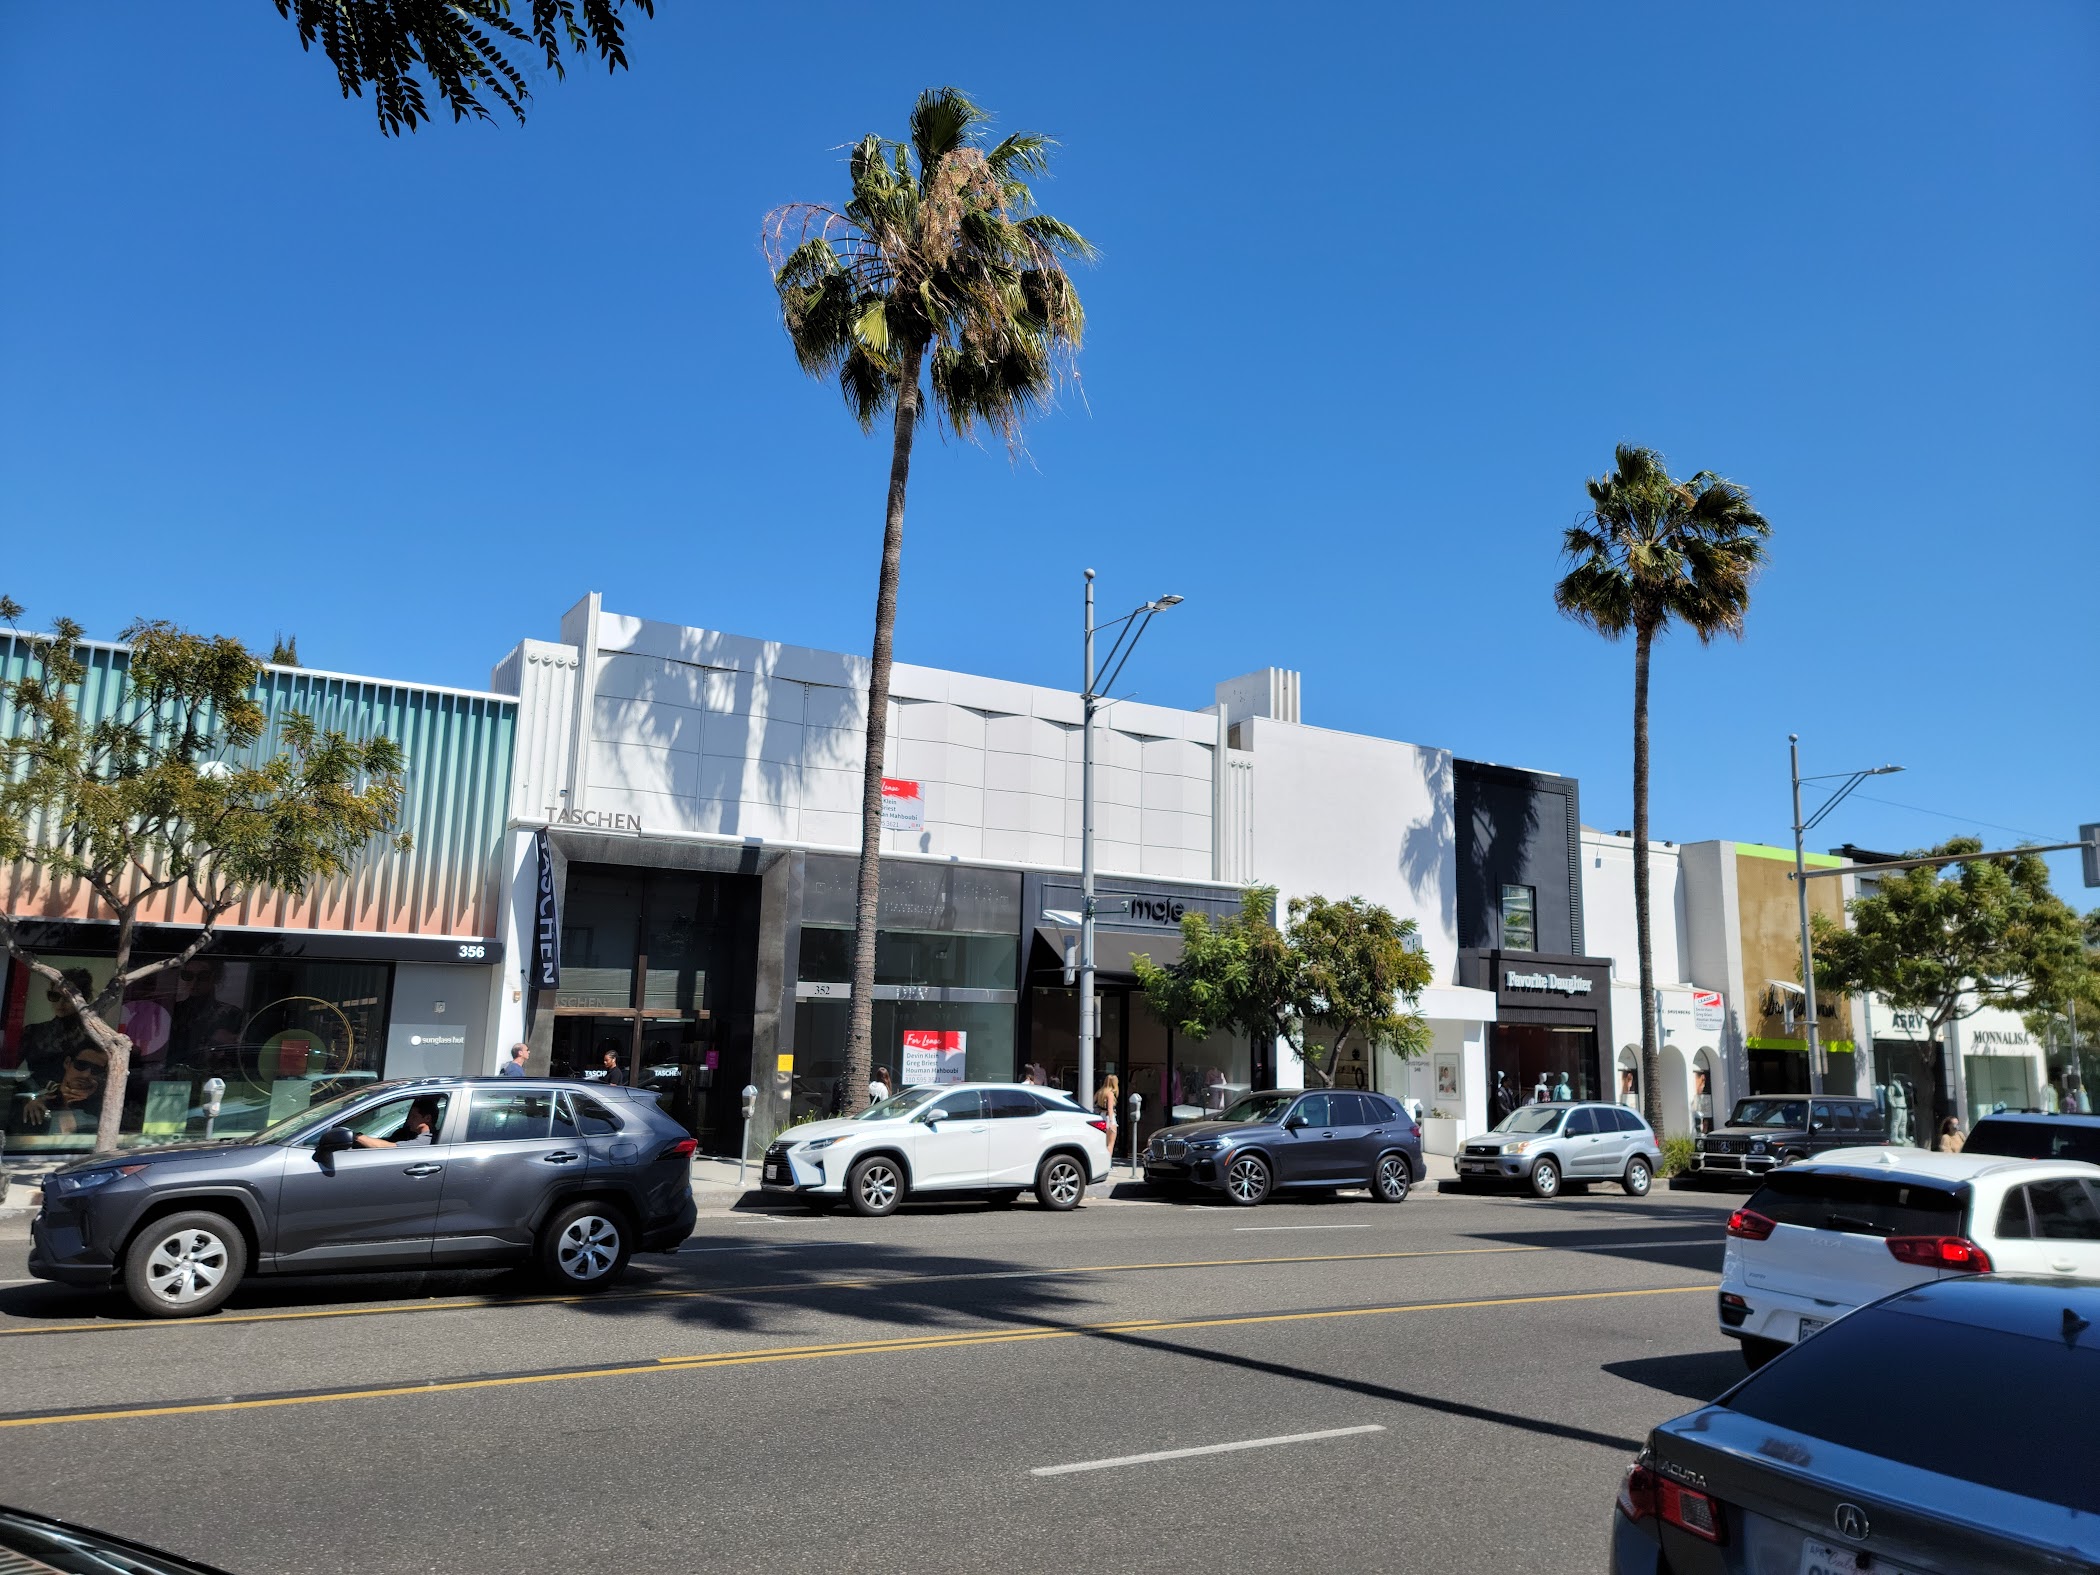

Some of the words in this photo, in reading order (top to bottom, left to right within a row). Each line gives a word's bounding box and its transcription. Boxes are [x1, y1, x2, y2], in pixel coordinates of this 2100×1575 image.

[545, 806, 641, 831] TASCHEN
[539, 835, 556, 984] TASCHEN
[1131, 898, 1185, 925] maje
[459, 945, 485, 958] 356
[1506, 970, 1548, 989] Favorite
[1547, 973, 1593, 994] Daughter
[814, 985, 831, 996] 352
[554, 996, 607, 1008] ASCHEN
[1892, 1013, 1923, 1029] ASRV
[422, 1036, 452, 1045] sunglass
[452, 1036, 464, 1044] hut
[906, 1033, 921, 1045] For
[921, 1034, 942, 1047] Lease
[1973, 1030, 2030, 1045] MONNALISA
[1661, 1460, 1707, 1487] ACURA
